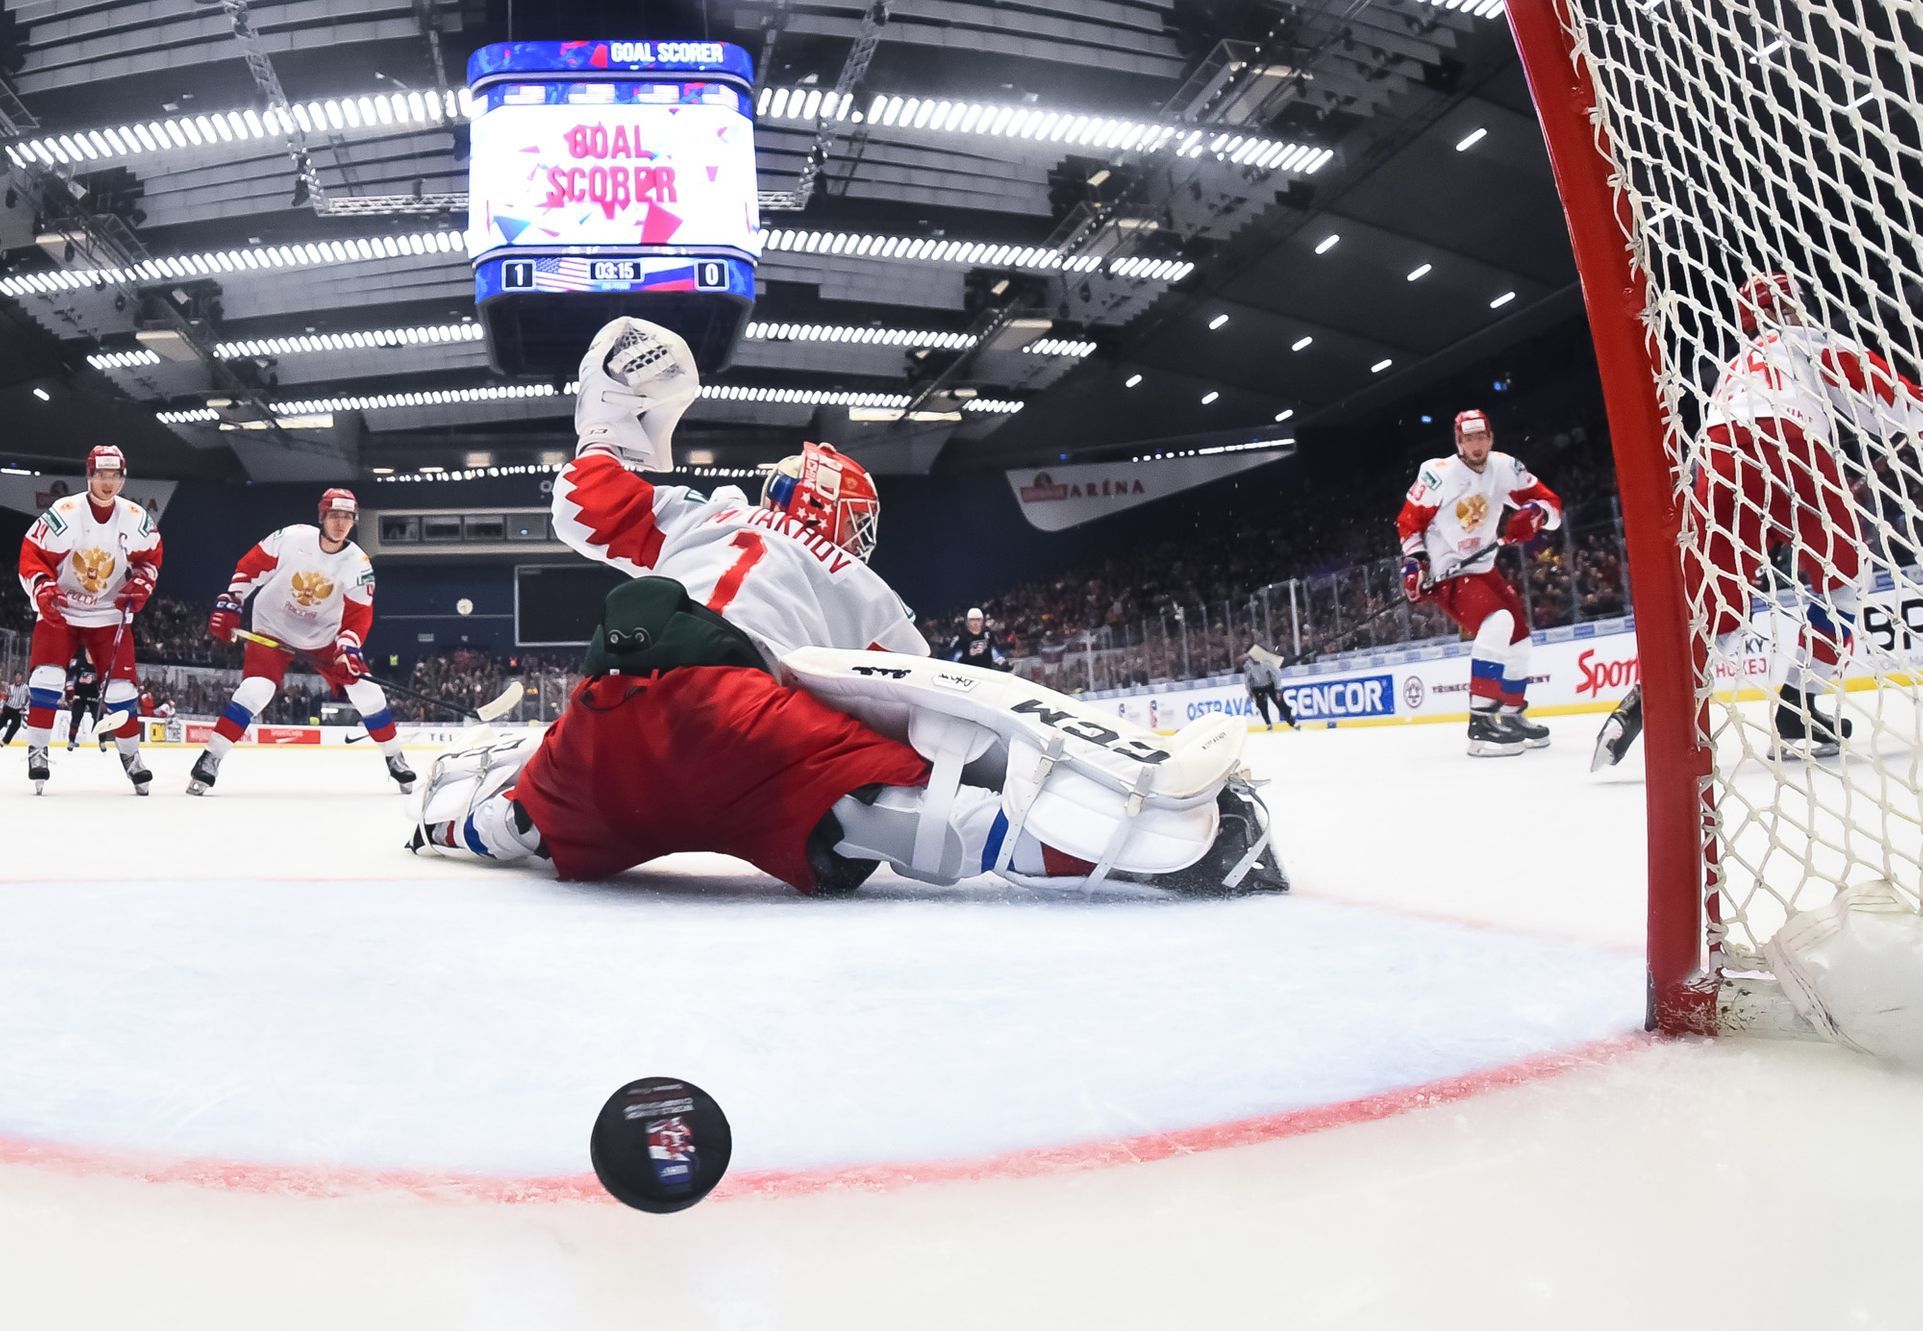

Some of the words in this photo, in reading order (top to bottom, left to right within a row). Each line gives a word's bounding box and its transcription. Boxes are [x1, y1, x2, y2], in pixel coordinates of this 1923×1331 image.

[610, 42, 656, 62] GOAL
[657, 42, 724, 63] SCORER
[514, 263, 525, 287] 1
[595, 262, 635, 280] 03:15
[704, 263, 719, 286] 0
[702, 507, 853, 574] MTAKHOV
[1187, 697, 1258, 722] OSTRAVA
[1283, 680, 1383, 717] SENCOR
[1010, 699, 1171, 765] CCM
